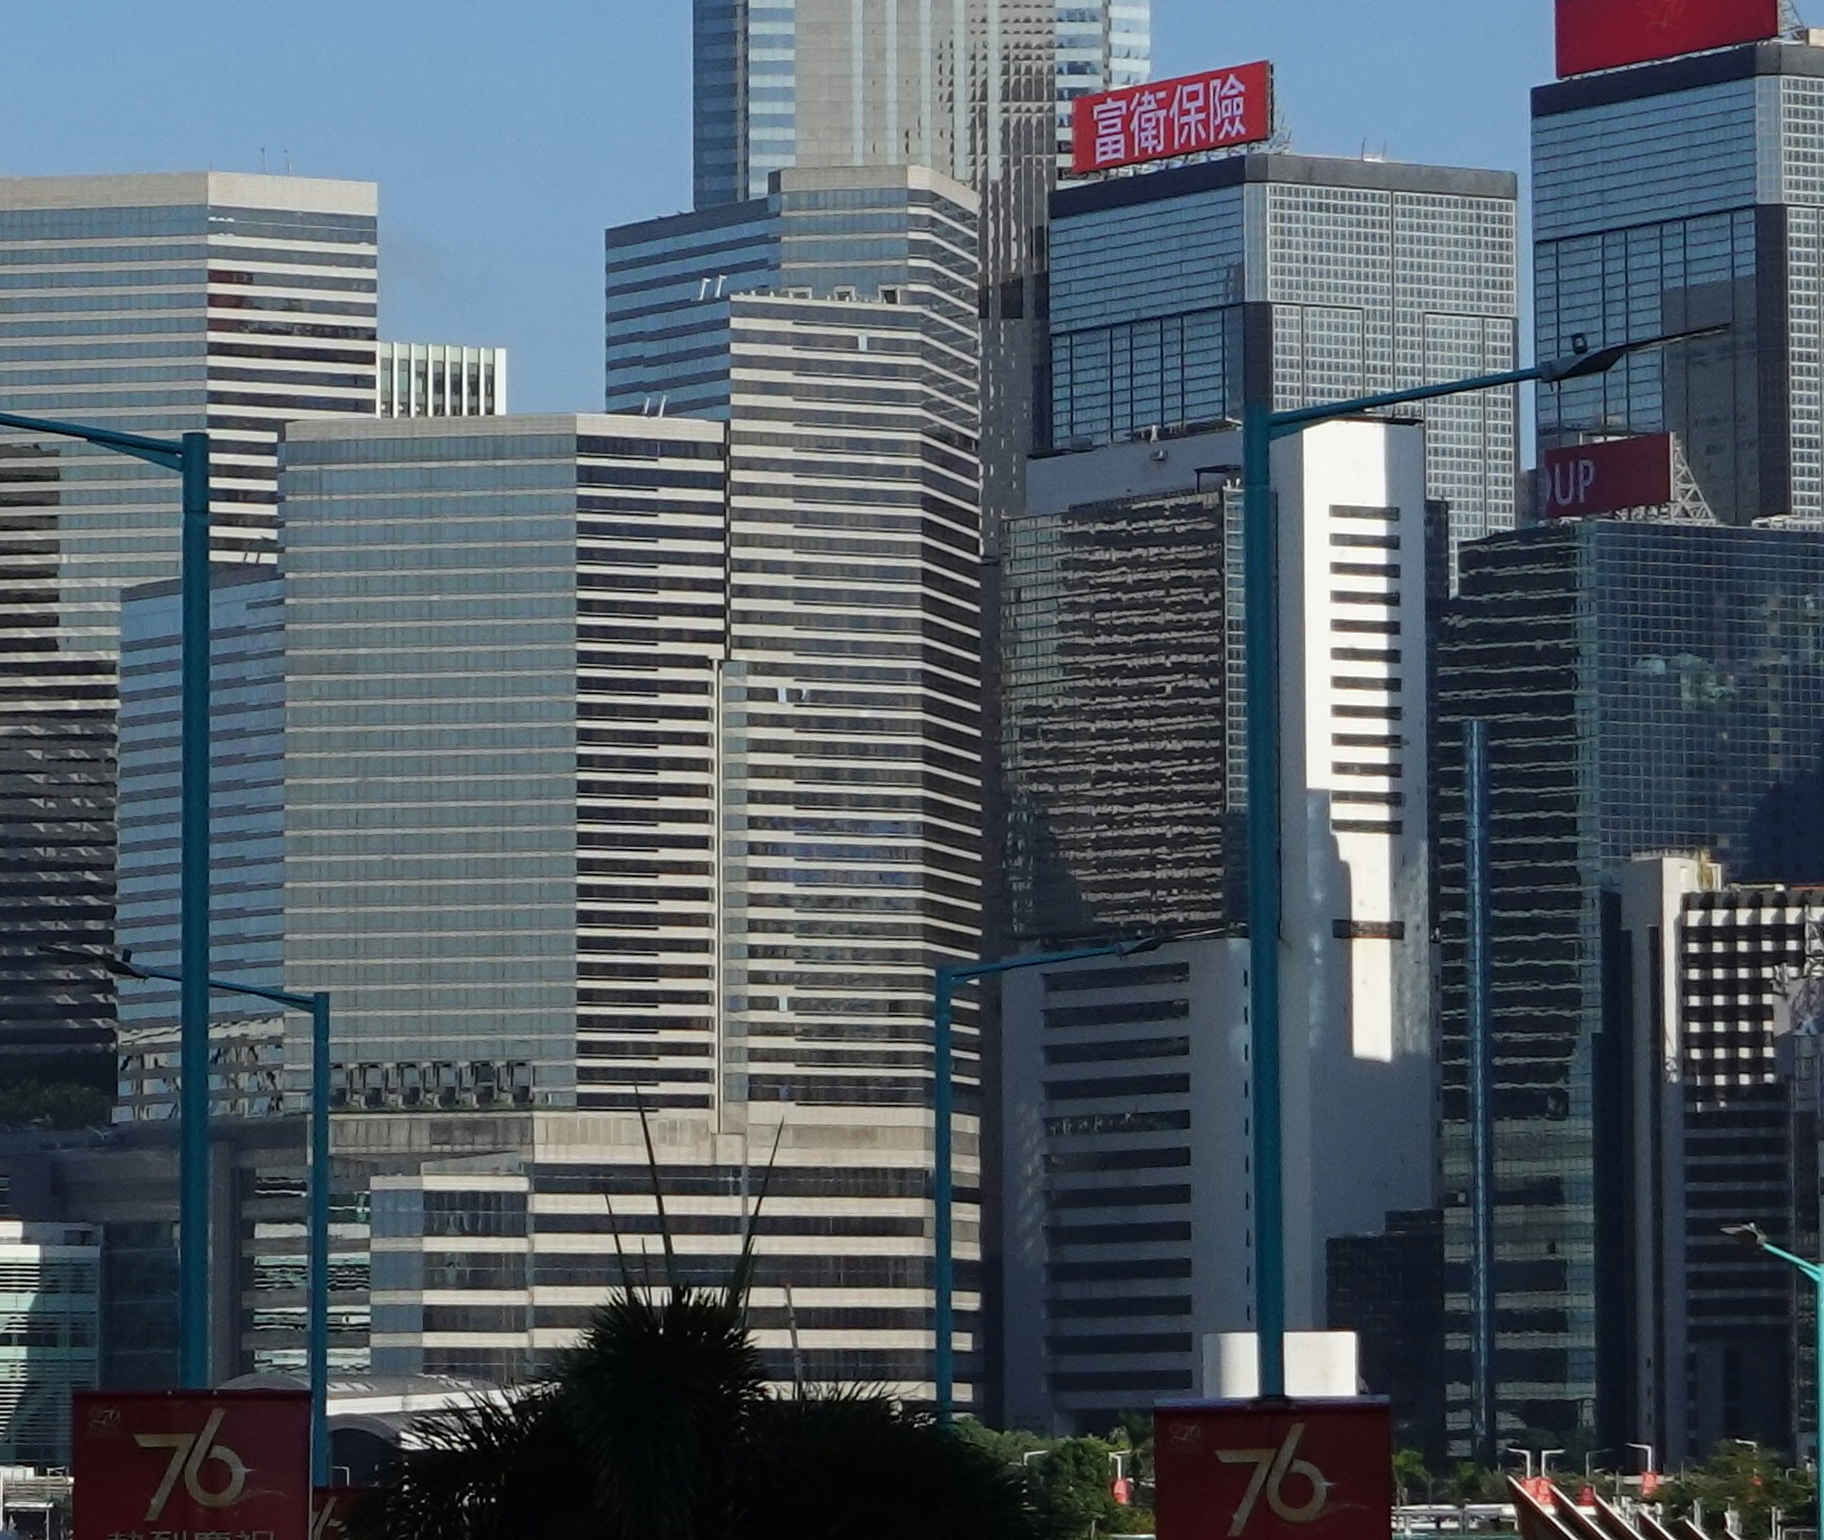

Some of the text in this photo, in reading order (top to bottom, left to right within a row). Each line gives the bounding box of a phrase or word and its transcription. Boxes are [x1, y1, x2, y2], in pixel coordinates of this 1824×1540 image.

[1093, 86, 1247, 165] 富衛保險
[133, 1408, 246, 1521] 76
[1215, 1422, 1327, 1536] 76
